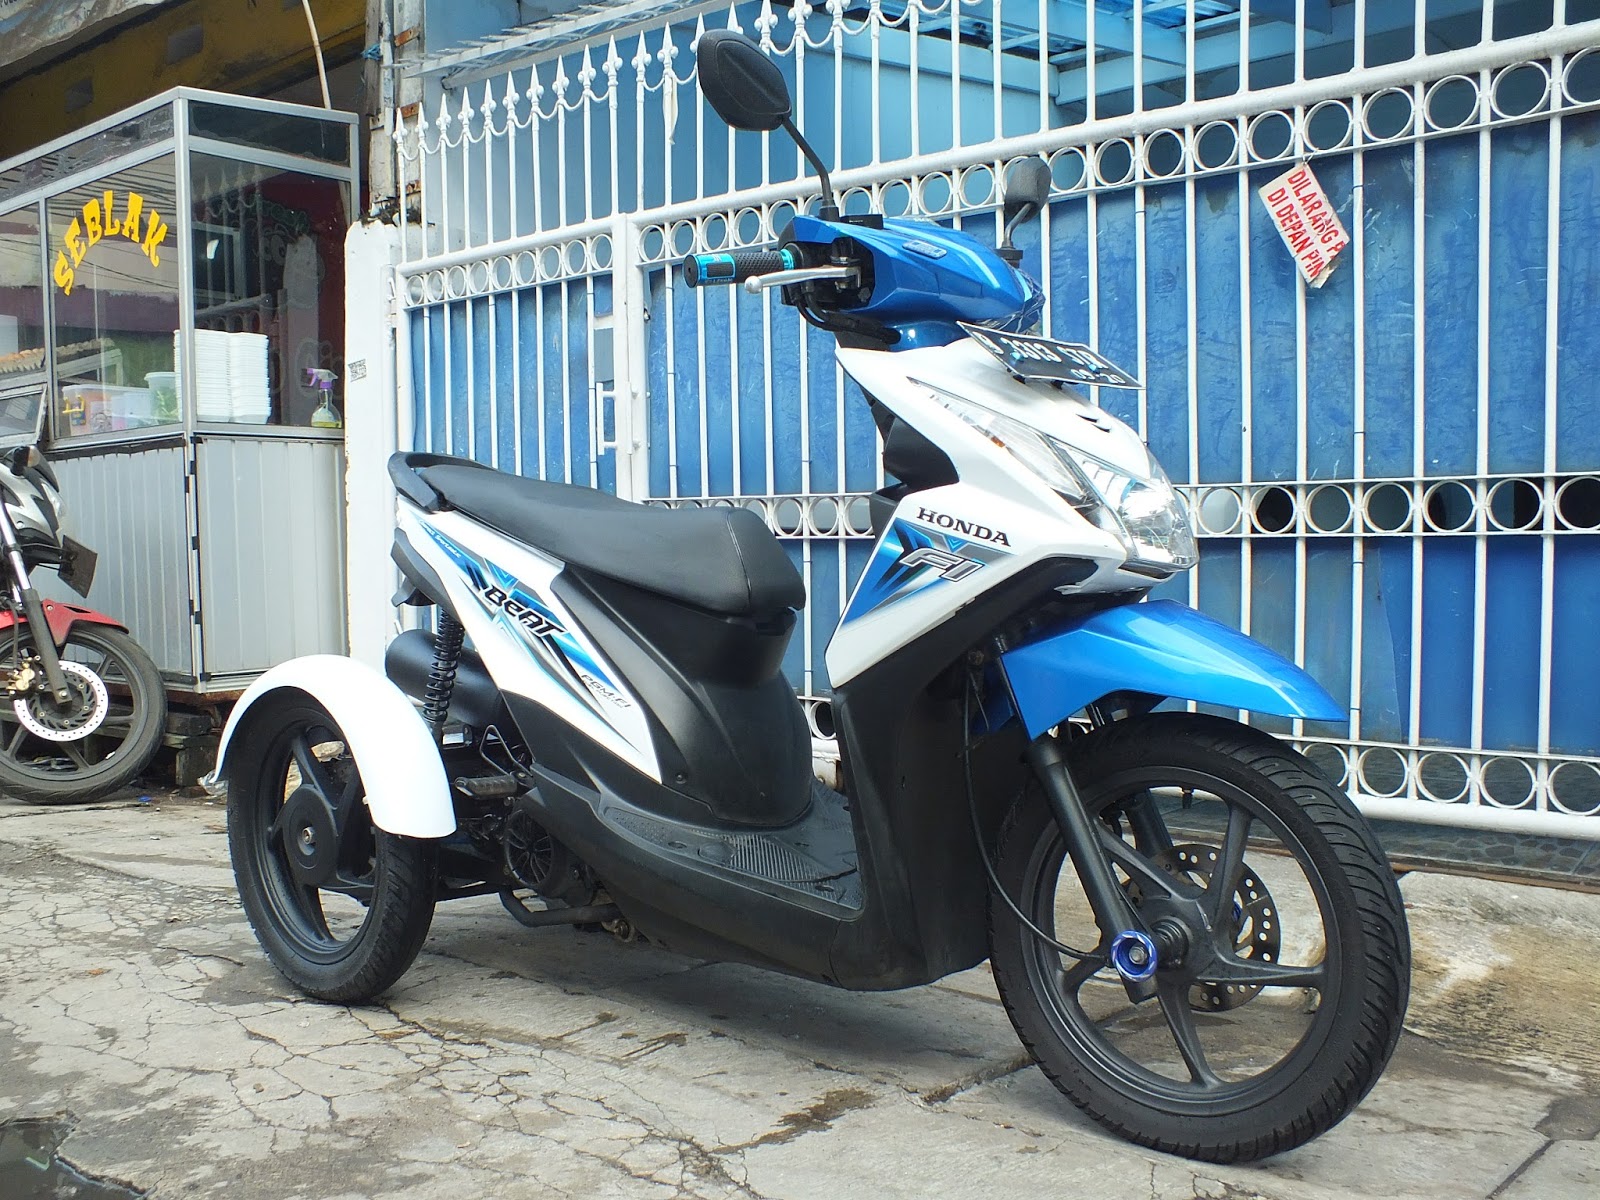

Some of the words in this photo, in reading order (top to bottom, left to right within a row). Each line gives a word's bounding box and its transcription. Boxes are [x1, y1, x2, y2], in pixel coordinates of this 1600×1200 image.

[1267, 187, 1290, 208] DI
[1287, 169, 1339, 245] DILARANG
[53, 190, 168, 295] SEBLAK
[1275, 203, 1315, 254] DEPAN
[916, 506, 1011, 548] HONDA
[899, 547, 985, 583] FI
